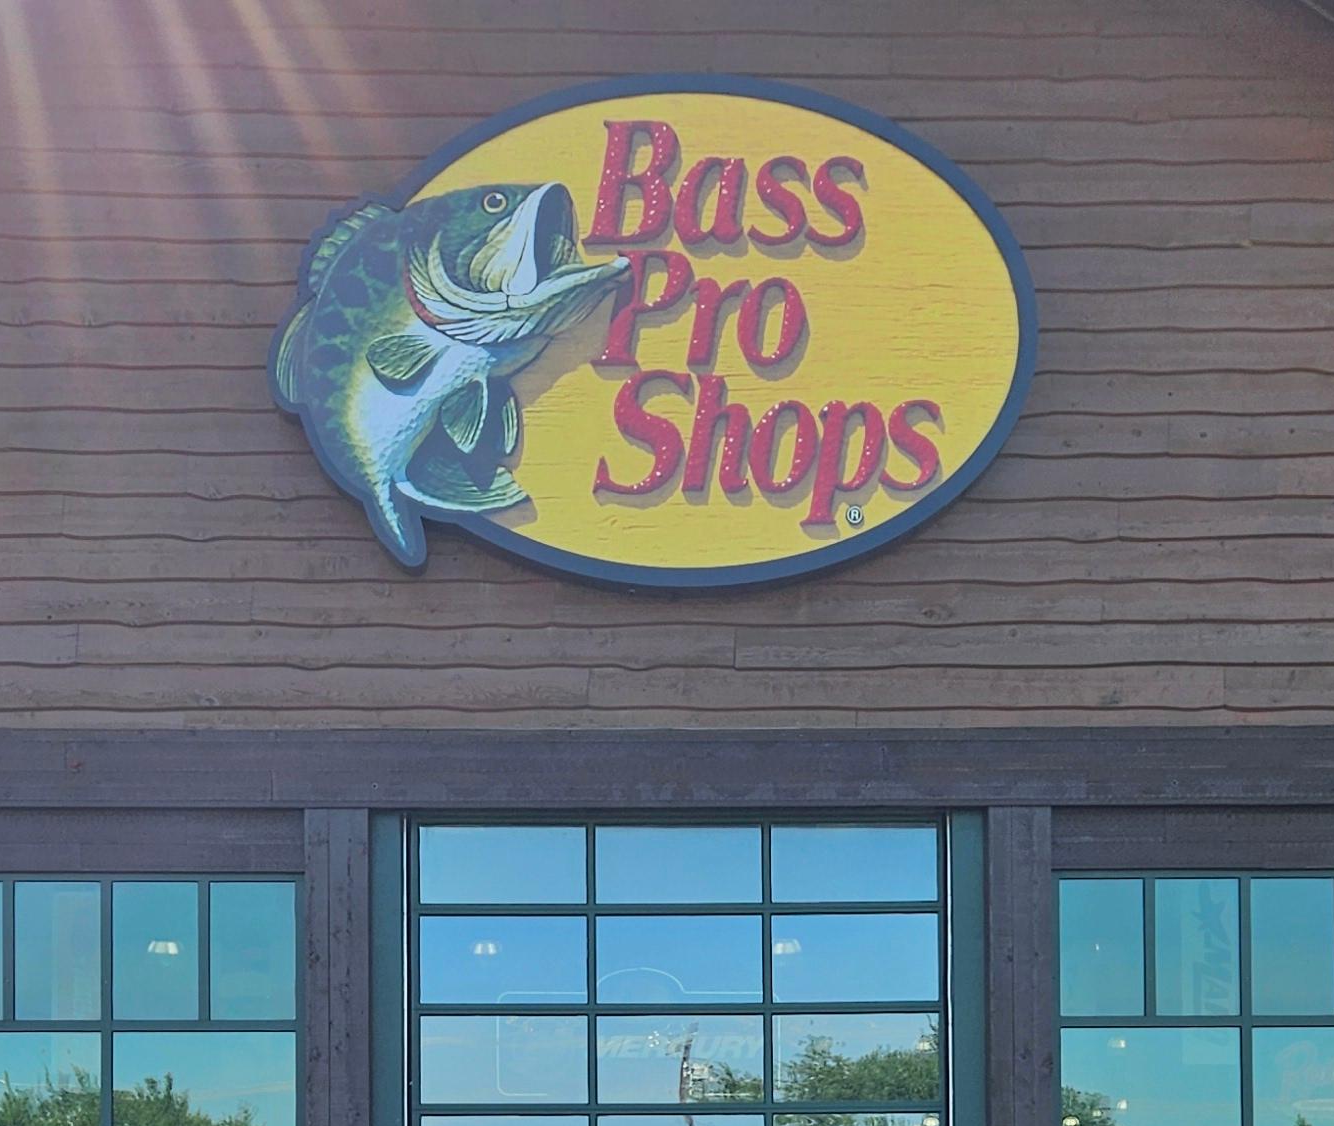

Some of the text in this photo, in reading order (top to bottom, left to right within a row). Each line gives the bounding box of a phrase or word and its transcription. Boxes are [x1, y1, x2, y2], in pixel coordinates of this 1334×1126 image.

[582, 119, 865, 248] Bass
[591, 249, 808, 369] Pro
[593, 369, 943, 528] Shops
